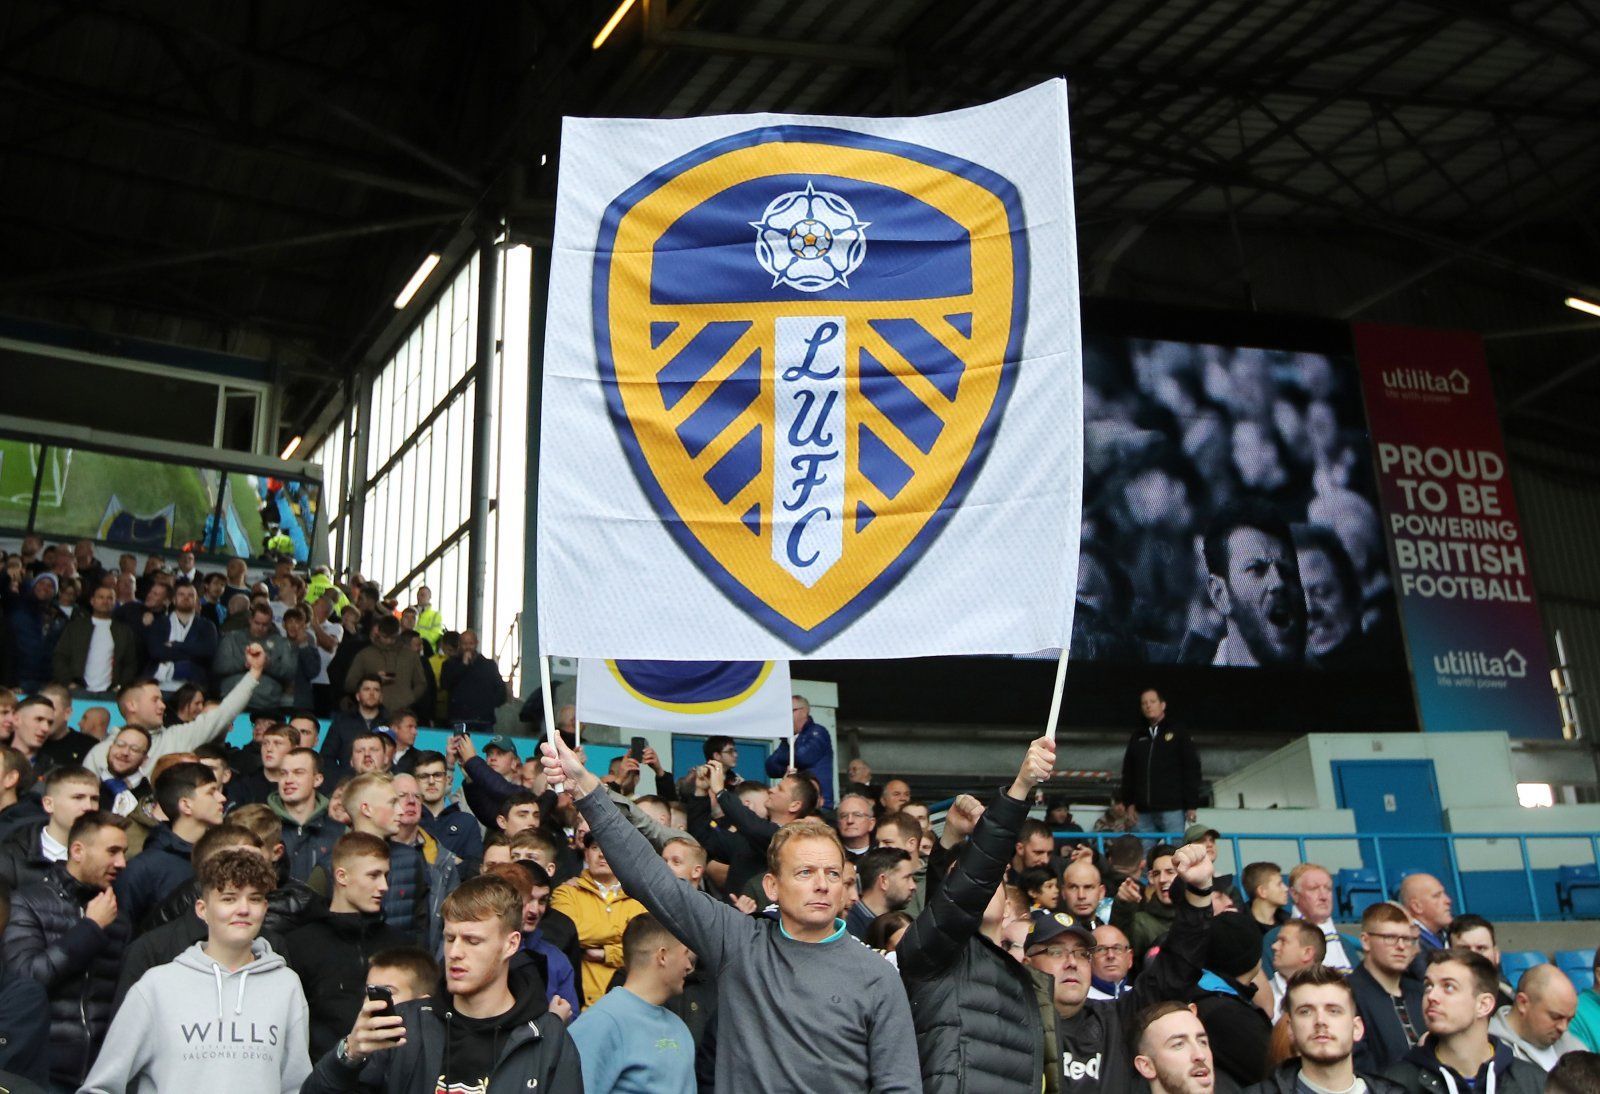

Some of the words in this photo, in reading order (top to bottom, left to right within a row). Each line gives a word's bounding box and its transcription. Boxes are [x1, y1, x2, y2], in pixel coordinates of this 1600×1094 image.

[1382, 368, 1450, 393] utilita
[1378, 443, 1504, 481] PROUD
[1397, 479, 1448, 512] TO
[1456, 483, 1502, 515] BE
[1390, 513, 1517, 541] POWERING
[1395, 539, 1526, 576] BRITISH
[1401, 573, 1532, 602] FOOTBALL
[1433, 651, 1506, 677] utilita
[181, 1021, 278, 1046] WILLS
